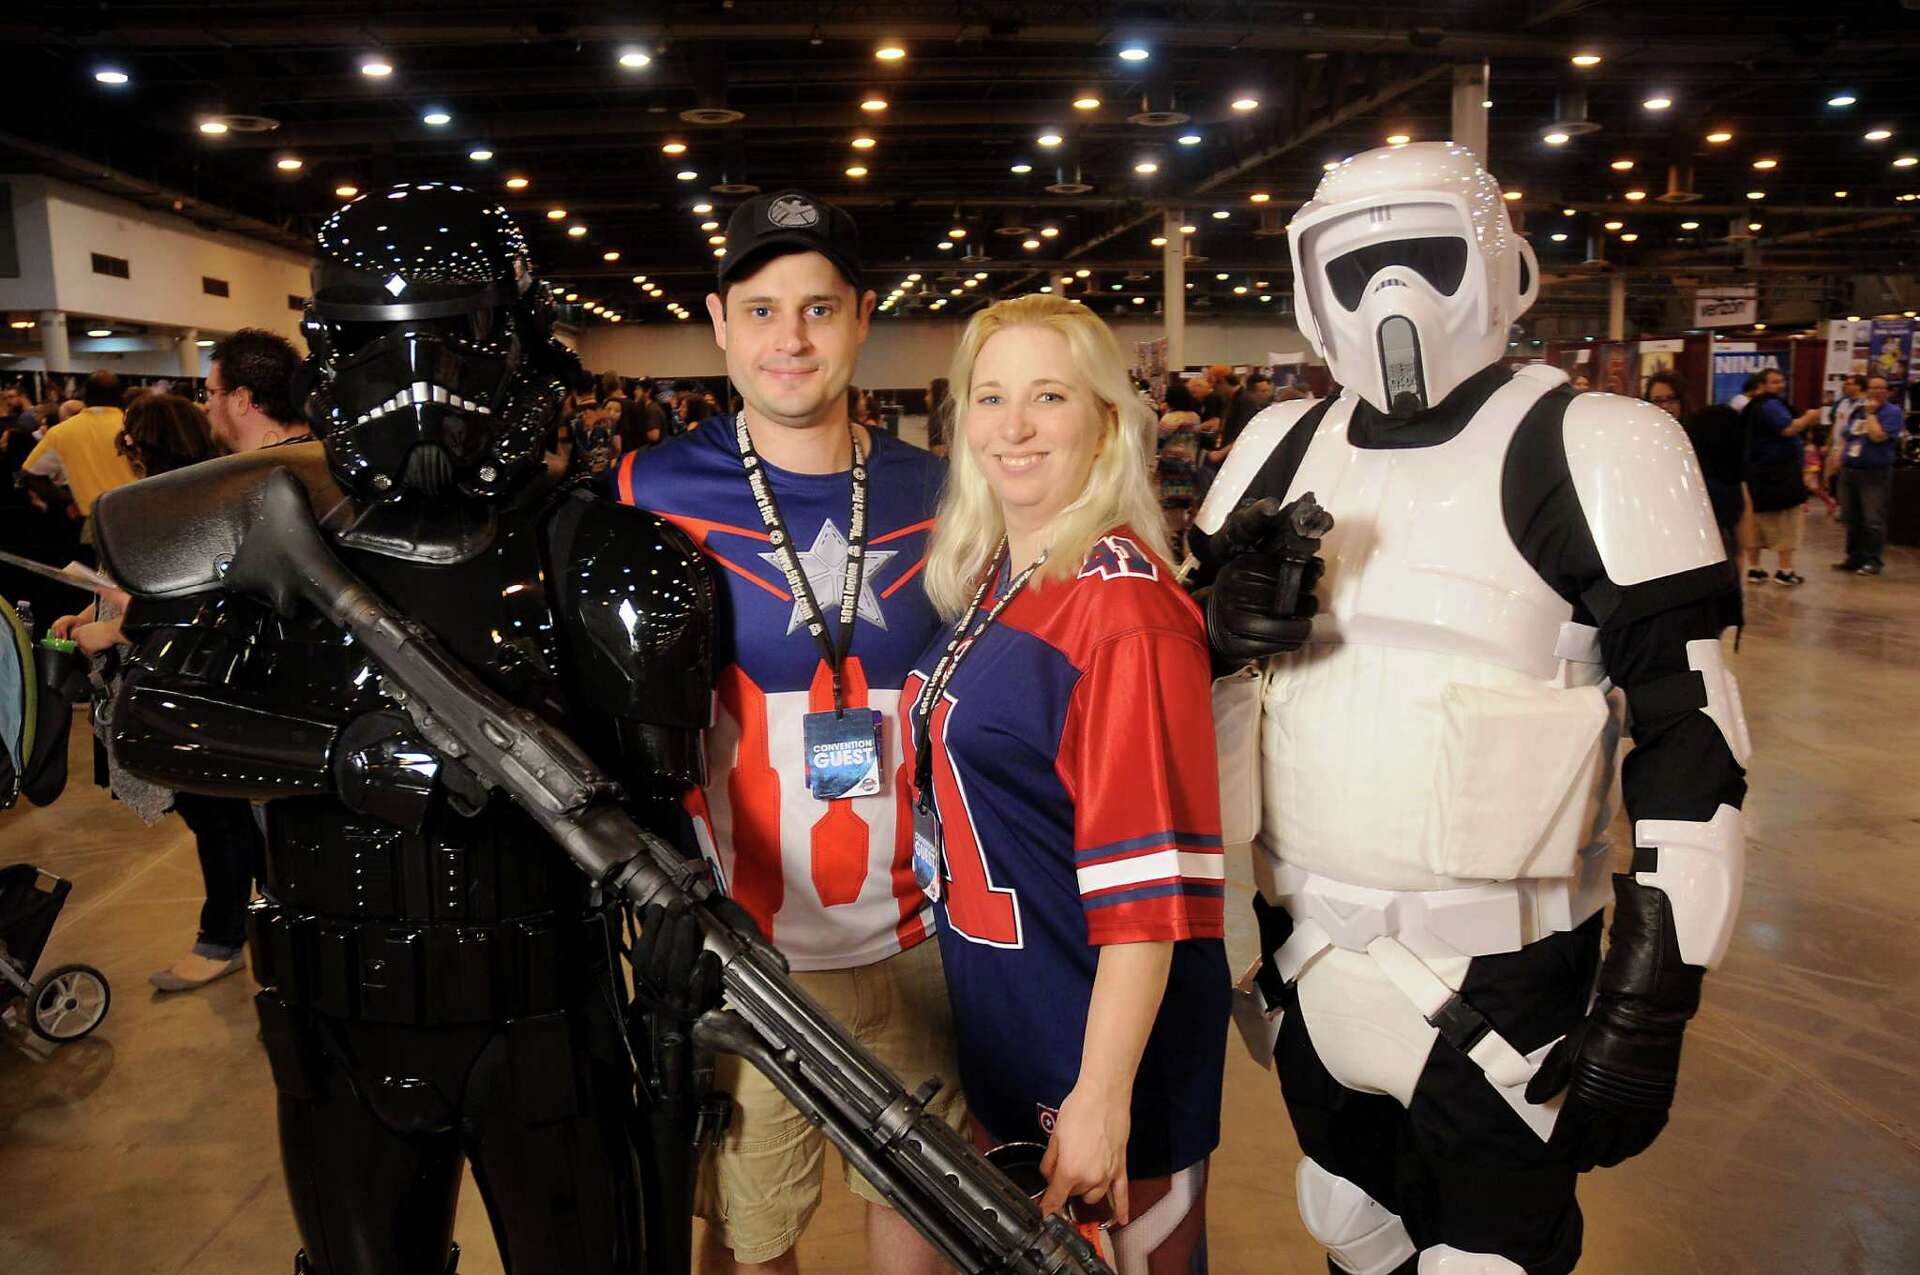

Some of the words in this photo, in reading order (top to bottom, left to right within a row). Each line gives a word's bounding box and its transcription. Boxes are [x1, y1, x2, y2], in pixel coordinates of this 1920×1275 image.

[1714, 355, 1779, 374] NINJA
[844, 562, 859, 597] Legion
[841, 596, 856, 624] 501st
[813, 739, 873, 753] CONVENTION
[813, 748, 874, 768] GUEST
